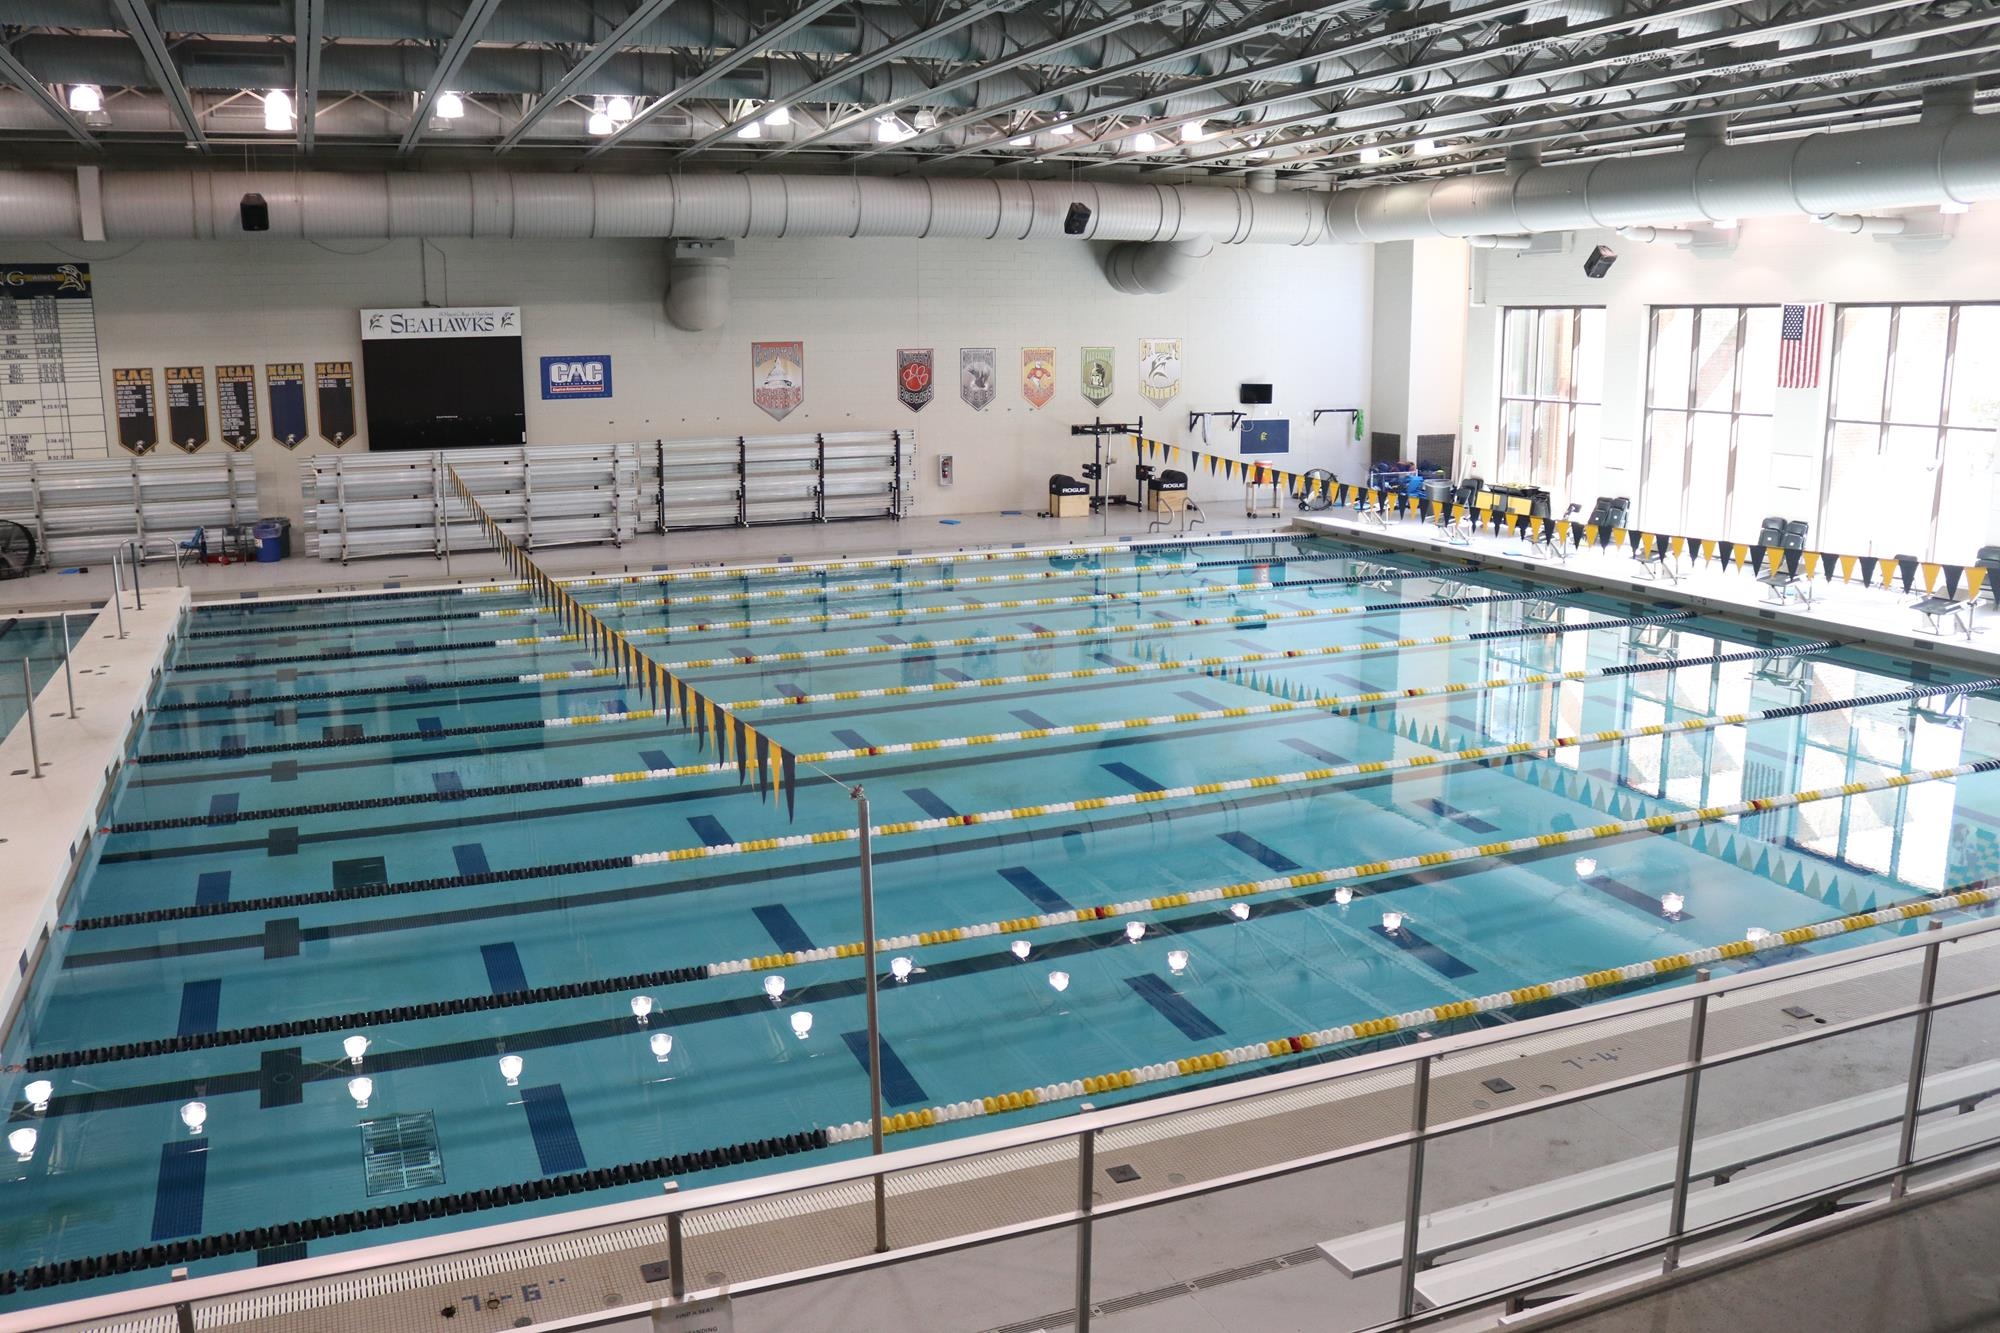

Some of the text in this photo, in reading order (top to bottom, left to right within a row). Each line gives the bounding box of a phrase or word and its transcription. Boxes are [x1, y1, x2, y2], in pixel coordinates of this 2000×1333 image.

[390, 313, 495, 334] SEAHAWKS
[166, 368, 203, 379] CAC
[218, 366, 253, 377] NCAA
[268, 364, 302, 376] NCAA
[316, 363, 351, 374] NCAA
[550, 362, 603, 383] CAC
[116, 369, 152, 380] CAC
